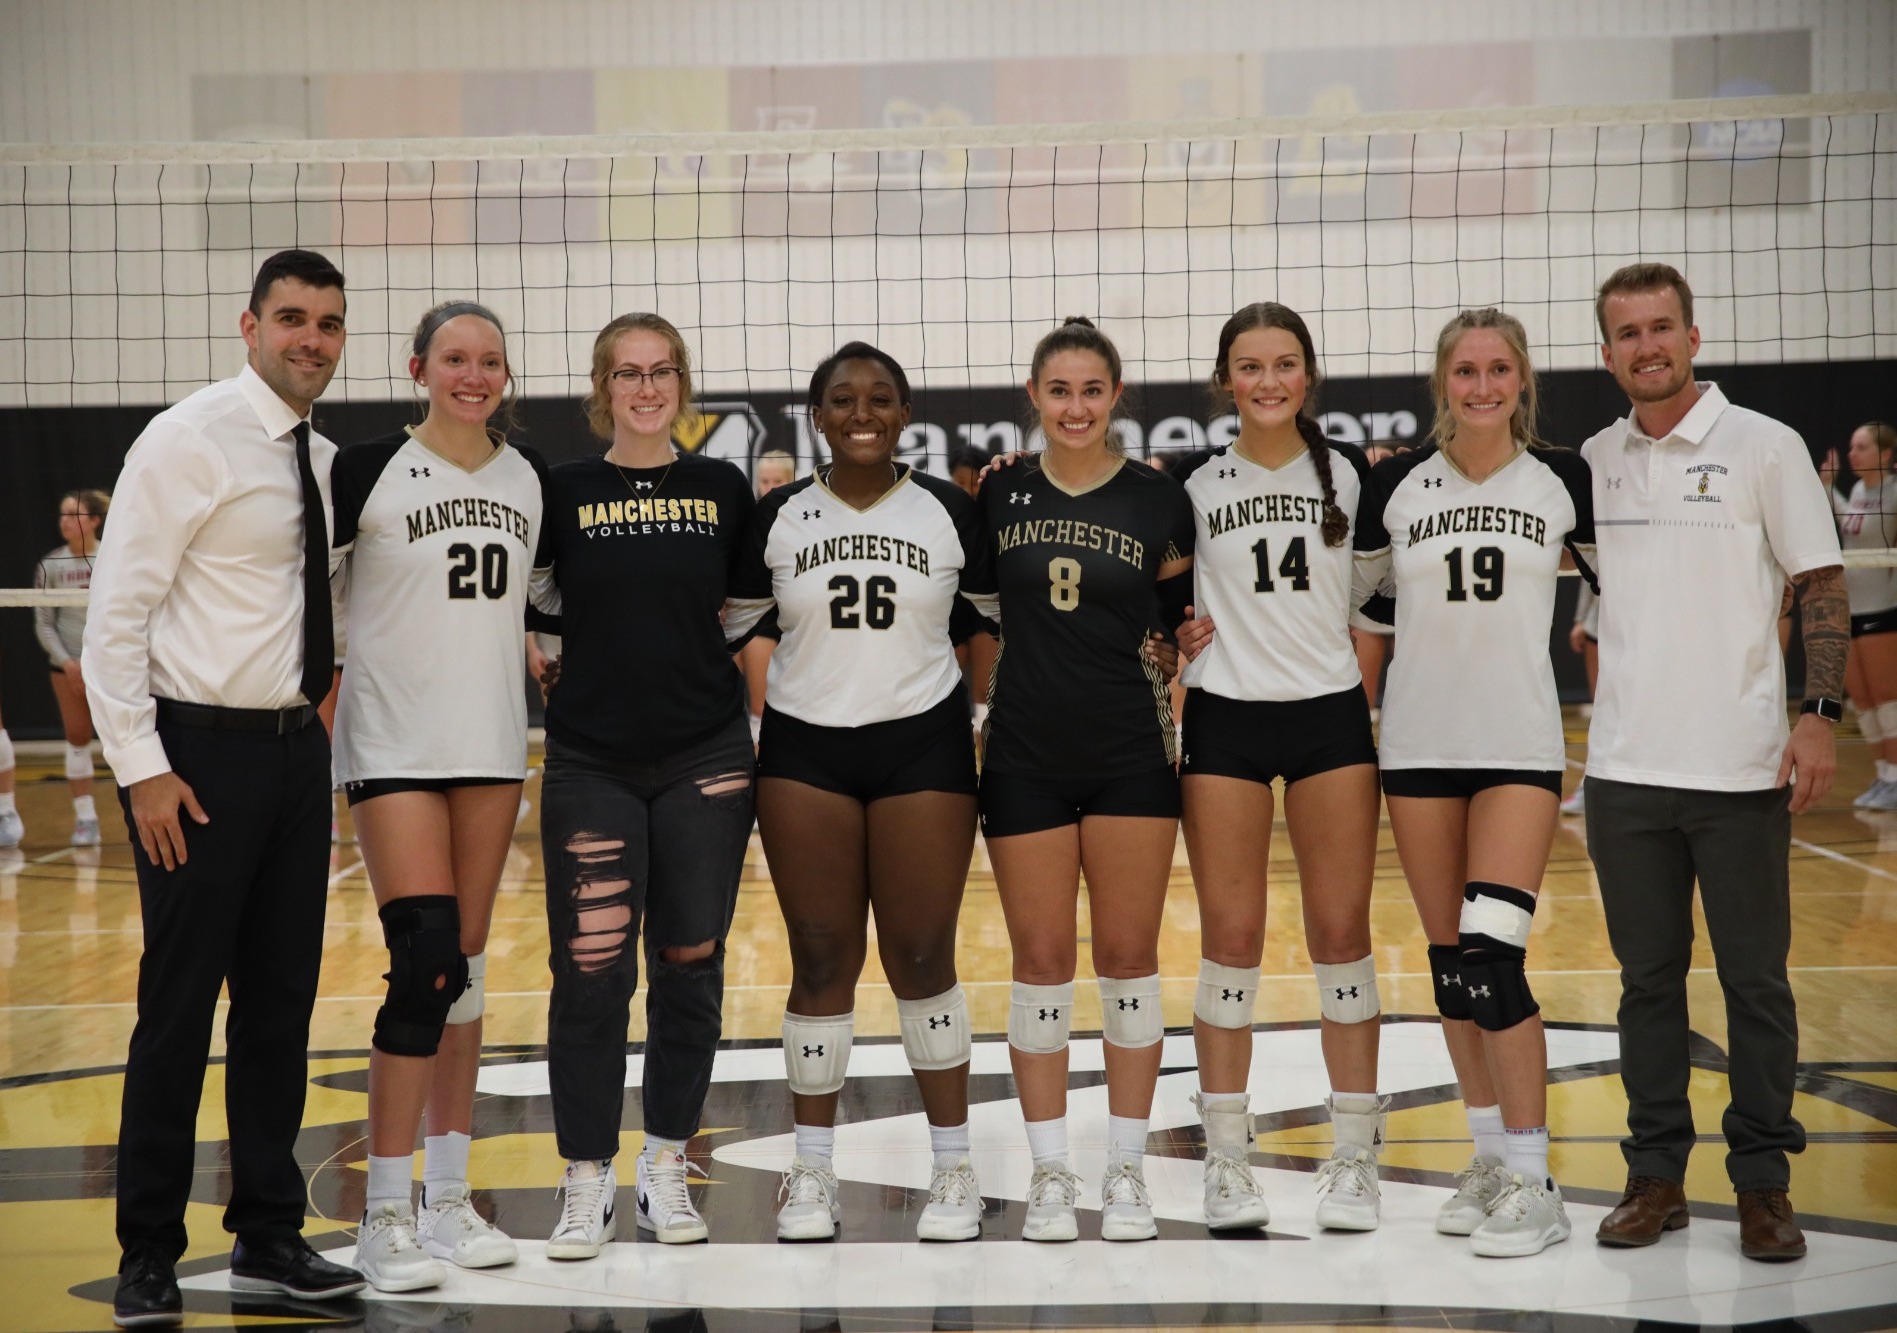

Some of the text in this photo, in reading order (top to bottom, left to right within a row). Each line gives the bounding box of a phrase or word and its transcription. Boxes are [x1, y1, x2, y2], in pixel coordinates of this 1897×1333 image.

[1685, 464, 1728, 476] MANCHESTER
[578, 498, 719, 530] MANCHESTER
[1208, 494, 1330, 539] MANCHEST
[1683, 495, 1721, 503] VOLLEYBALL
[406, 498, 530, 549] MANCHESTER
[587, 522, 715, 540] VOLLEYBALL
[998, 519, 1146, 572] MANCHESTER
[1407, 505, 1546, 548] MANCHESTER
[447, 542, 509, 600] 20
[794, 534, 931, 579] MANCHESTER
[1250, 536, 1310, 593] 14
[1444, 546, 1505, 602] 19
[827, 574, 897, 631] 26
[1048, 556, 1082, 612] 8
